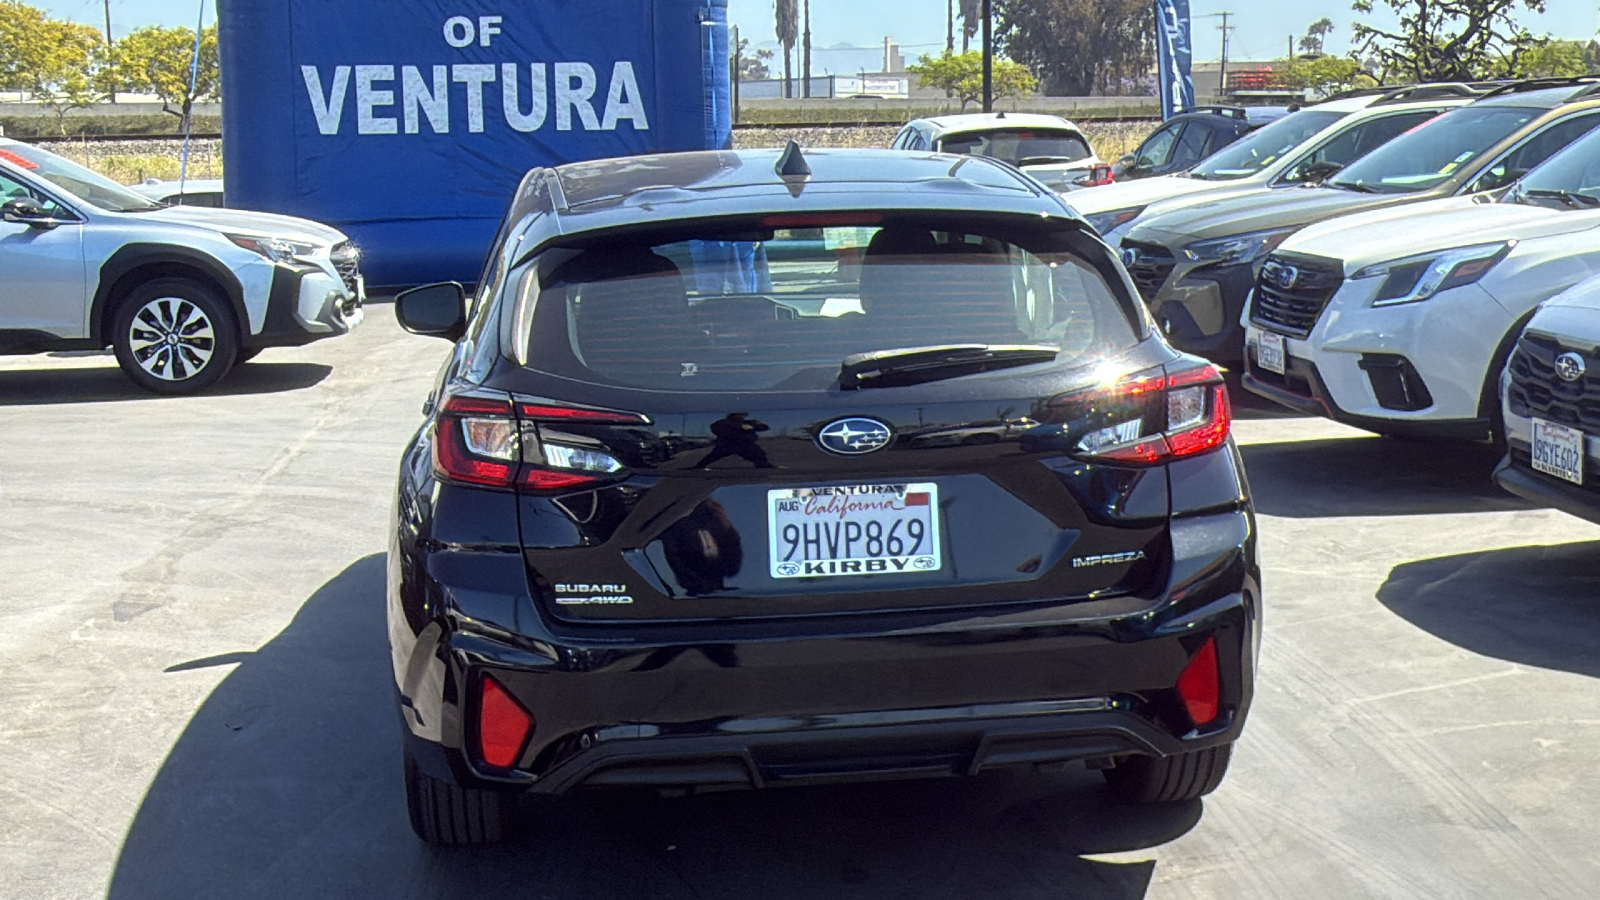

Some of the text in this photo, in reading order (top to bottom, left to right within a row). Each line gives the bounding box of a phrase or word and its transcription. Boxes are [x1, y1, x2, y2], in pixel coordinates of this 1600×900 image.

[443, 16, 502, 47] OF
[301, 61, 649, 135] VENTURA
[811, 485, 899, 497] VENTURA
[778, 501, 799, 512] AUG
[804, 495, 905, 520] California
[782, 518, 924, 562] 9HVP869
[804, 558, 909, 575] KIRBY
[555, 583, 626, 593] SUBARU
